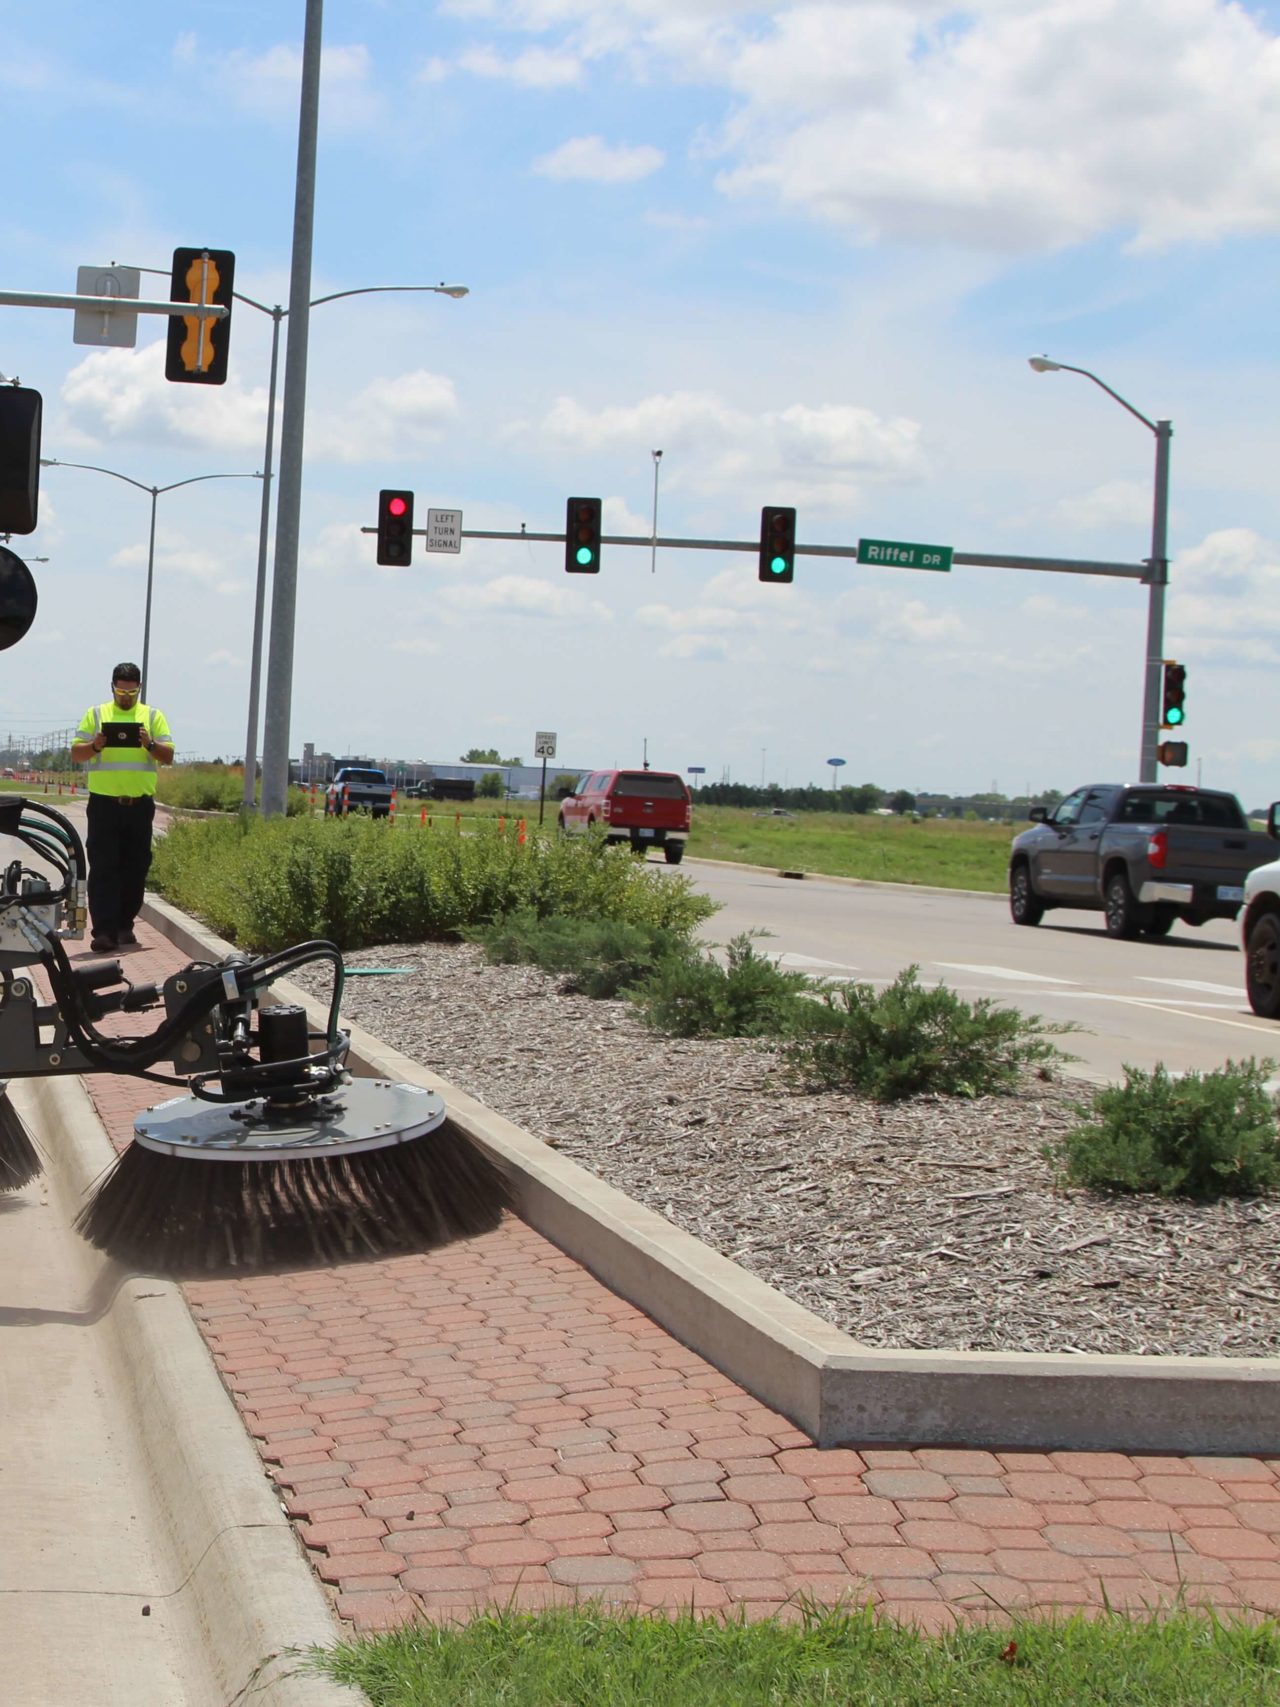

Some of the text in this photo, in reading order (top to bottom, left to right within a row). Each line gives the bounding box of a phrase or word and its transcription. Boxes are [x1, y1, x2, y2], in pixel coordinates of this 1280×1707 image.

[435, 514, 455, 523] LEFT
[434, 526, 456, 536] TURN
[429, 538, 458, 549] SIGNAL
[867, 545, 942, 565] Riffel DR
[537, 745, 555, 755] 40
